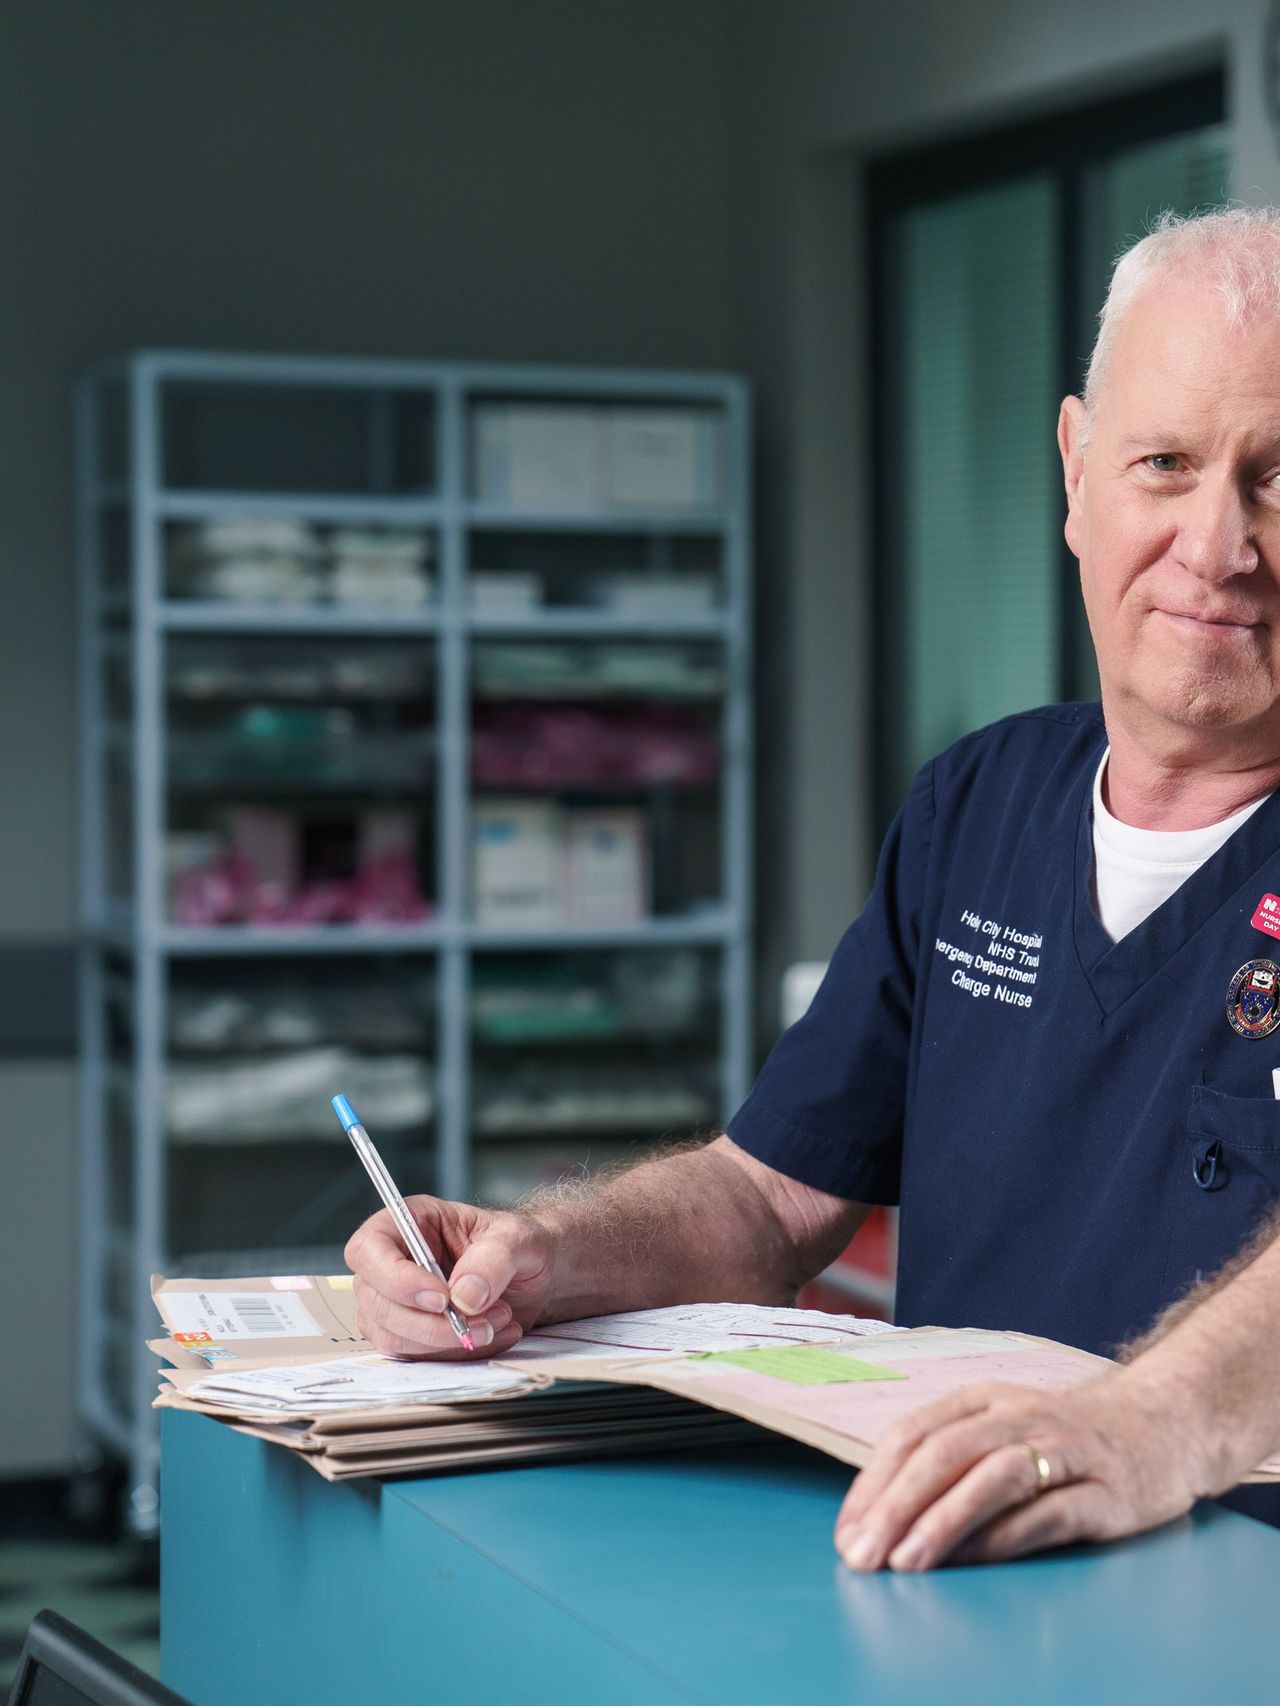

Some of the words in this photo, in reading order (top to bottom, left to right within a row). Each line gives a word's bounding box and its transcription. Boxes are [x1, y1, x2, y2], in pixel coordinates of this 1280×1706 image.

[1263, 921, 1279, 931] DAY
[987, 941, 1016, 960] NHS
[974, 955, 1037, 984] Department
[951, 969, 991, 997] Charge
[993, 984, 1033, 1008] Nurse
